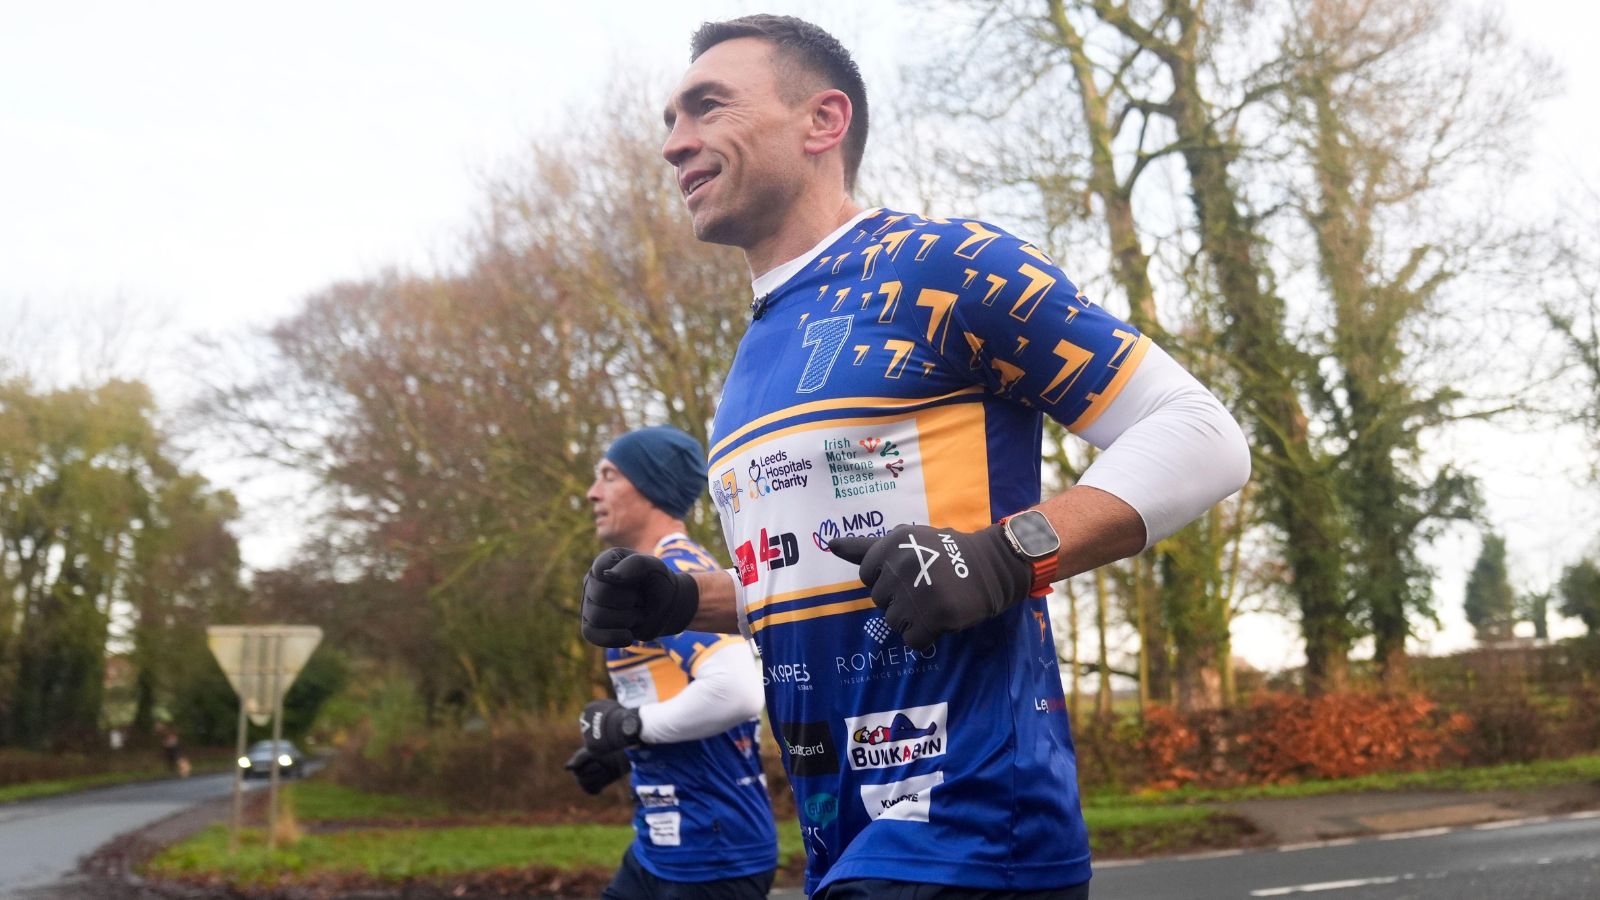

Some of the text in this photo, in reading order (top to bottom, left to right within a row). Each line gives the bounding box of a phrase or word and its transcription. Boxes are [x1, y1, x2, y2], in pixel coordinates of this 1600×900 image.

[796, 314, 855, 393] 7
[824, 437, 851, 451] Irish
[760, 449, 788, 467] Leeds
[825, 450, 857, 462] Motor
[766, 458, 813, 479] Hospitals
[828, 460, 874, 474] Neurone
[771, 474, 808, 491] Charity
[832, 472, 874, 486] Disease
[835, 480, 896, 499] Association
[842, 510, 884, 532] MND
[937, 533, 969, 579] NEXO
[835, 642, 937, 674] ROMERO
[852, 738, 942, 767] BUNKABIN
